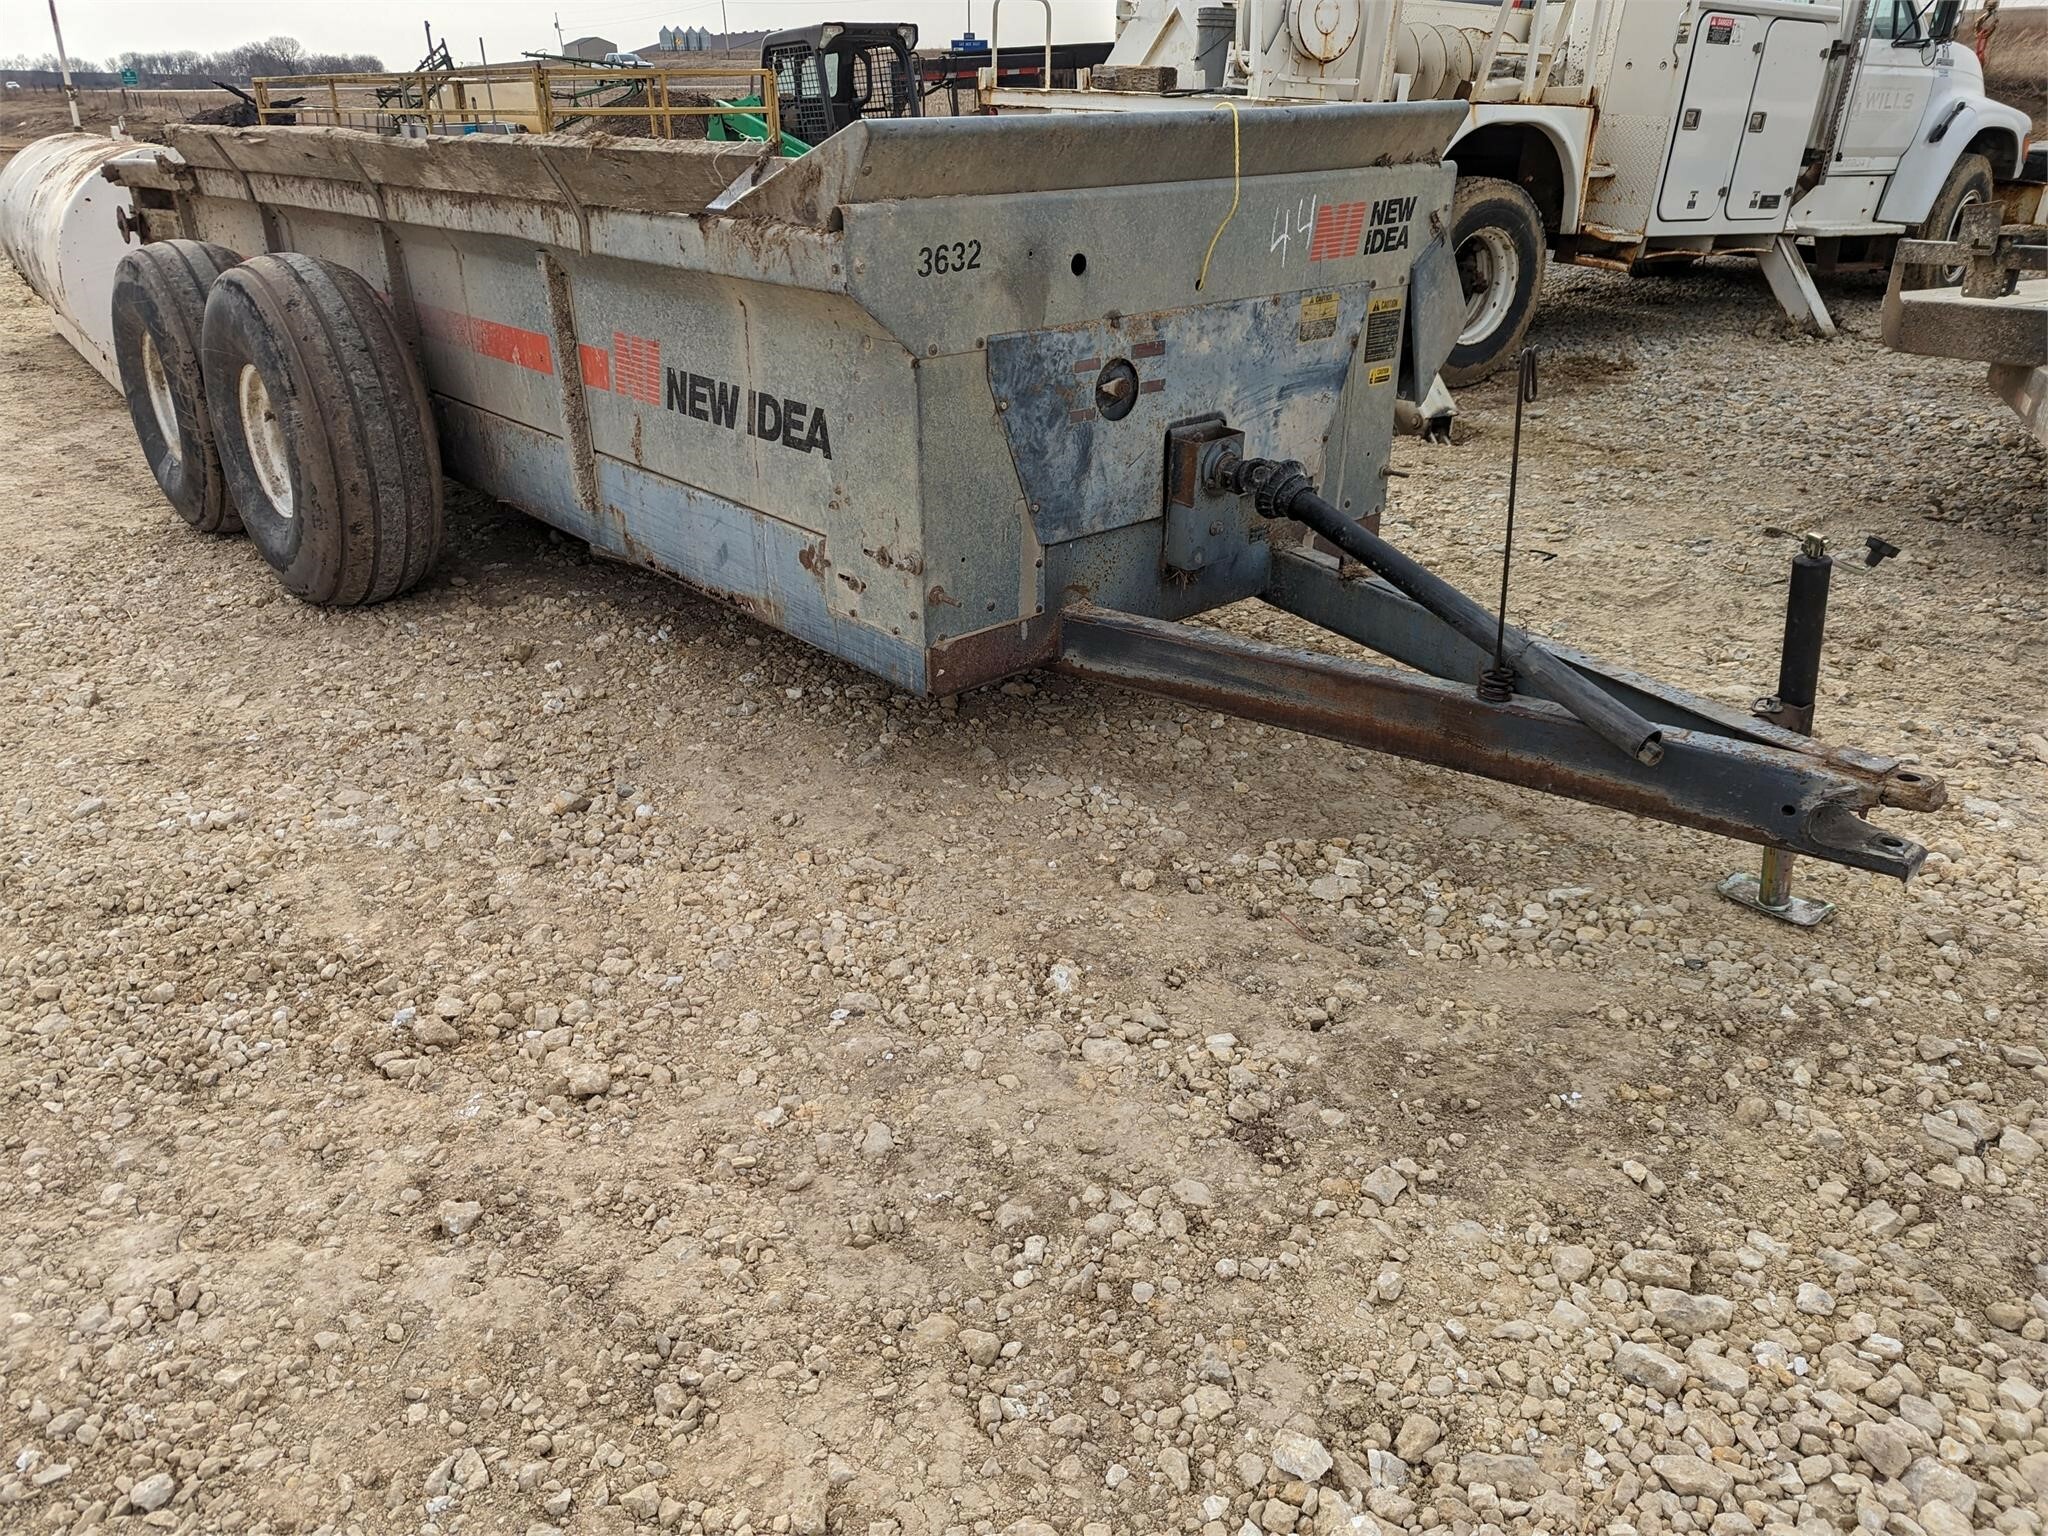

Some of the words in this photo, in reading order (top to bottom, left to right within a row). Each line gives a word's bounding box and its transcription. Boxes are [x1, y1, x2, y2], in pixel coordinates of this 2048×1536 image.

[1865, 91, 1915, 110] WILLS
[1369, 196, 1418, 227] NEW
[1270, 193, 1317, 268] 44
[1363, 225, 1409, 256] IDEA
[917, 239, 982, 278] 3632
[666, 366, 740, 430] NEW
[746, 388, 833, 461] IDEA
